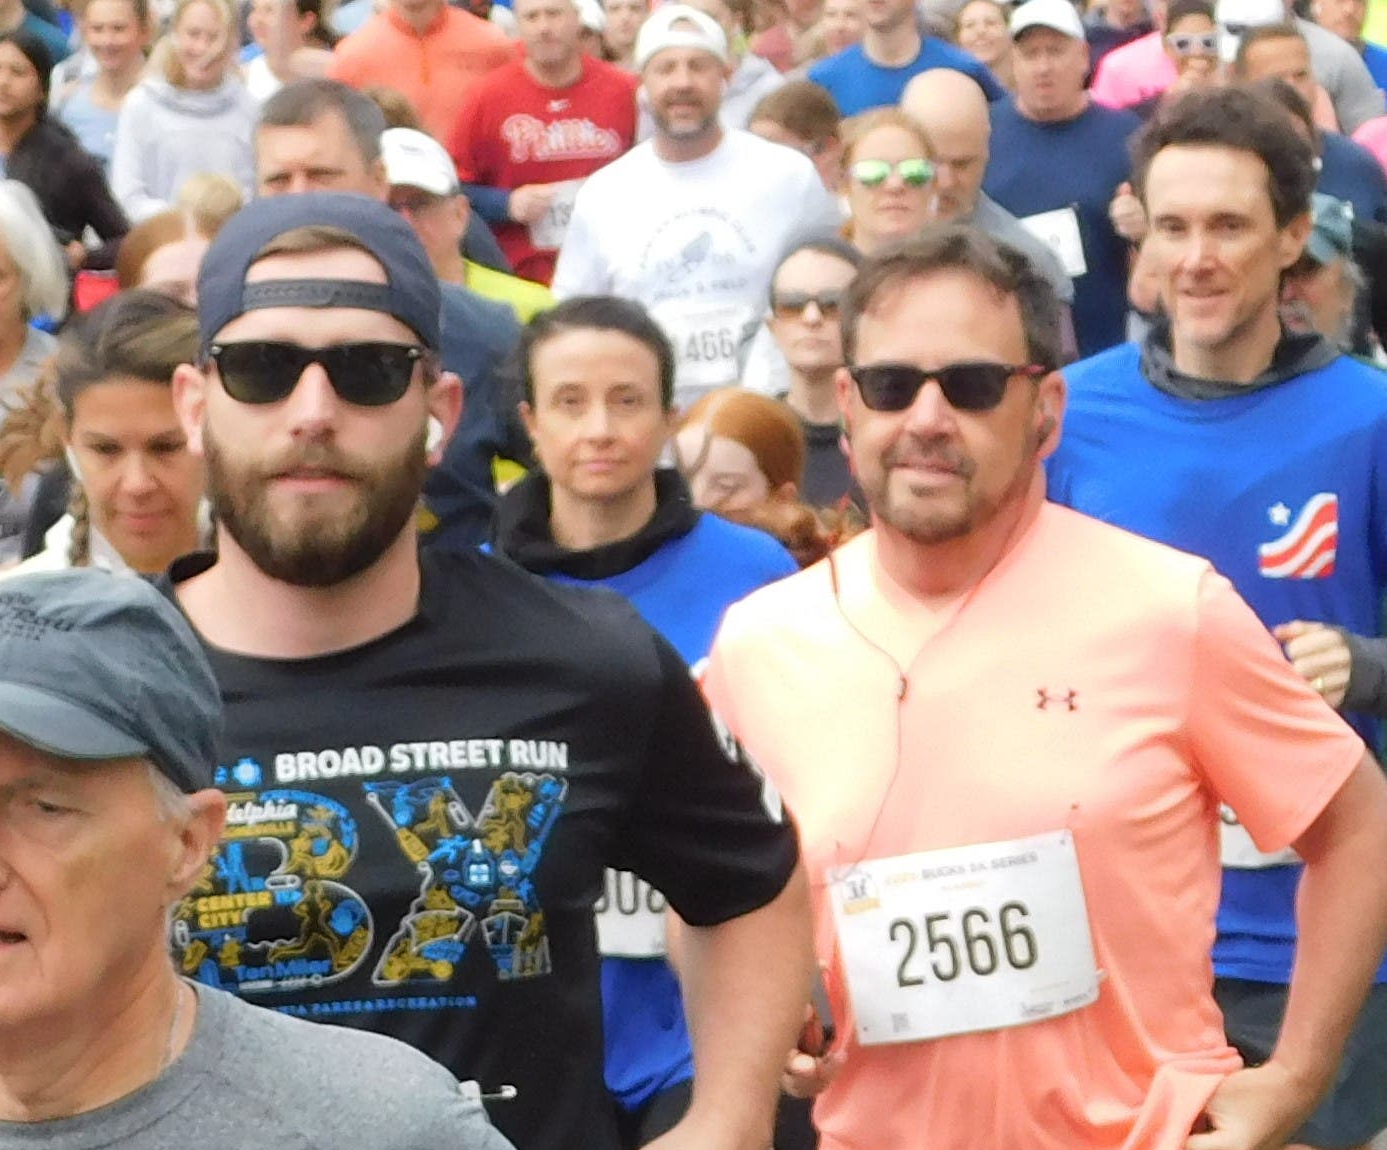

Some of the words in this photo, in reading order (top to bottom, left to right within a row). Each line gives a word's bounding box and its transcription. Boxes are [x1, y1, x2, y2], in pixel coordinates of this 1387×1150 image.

[685, 328, 735, 362] 466
[275, 745, 383, 783] BROAD
[390, 740, 503, 773] STREET
[510, 738, 569, 770] RUN
[226, 799, 299, 826] delphia
[197, 891, 272, 913] CENTER
[198, 910, 241, 929] CITY
[888, 900, 1039, 988] 2566
